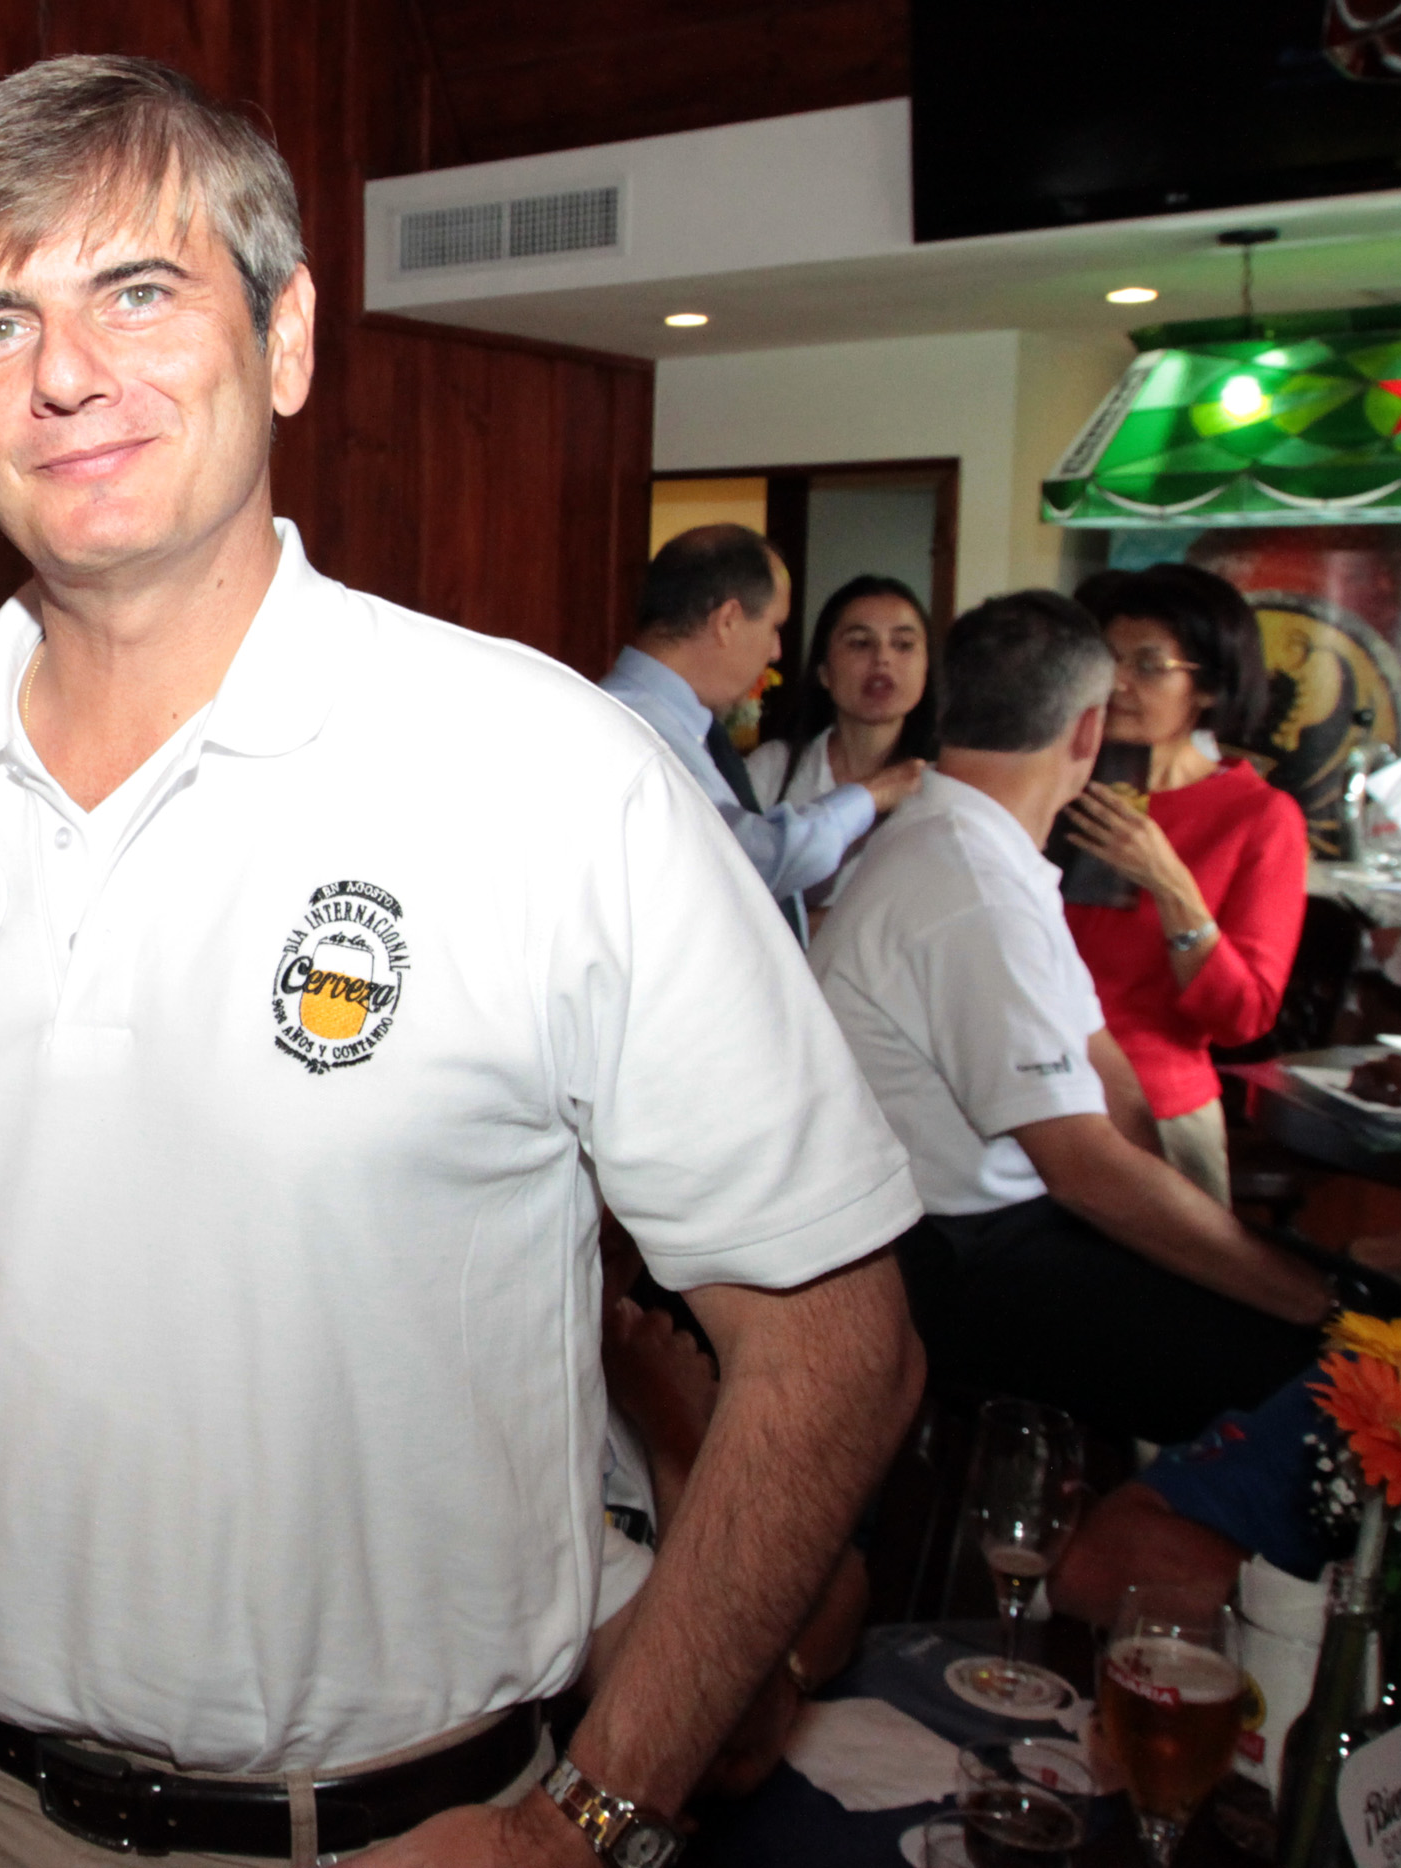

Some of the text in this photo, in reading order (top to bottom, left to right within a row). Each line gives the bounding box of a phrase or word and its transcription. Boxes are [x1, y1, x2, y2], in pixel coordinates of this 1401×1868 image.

[346, 881, 394, 908] AGOSTO
[304, 901, 411, 973] INTERNACIONAL
[280, 956, 396, 1014] Cerveza
[332, 1017, 394, 1059] CONTANDO
